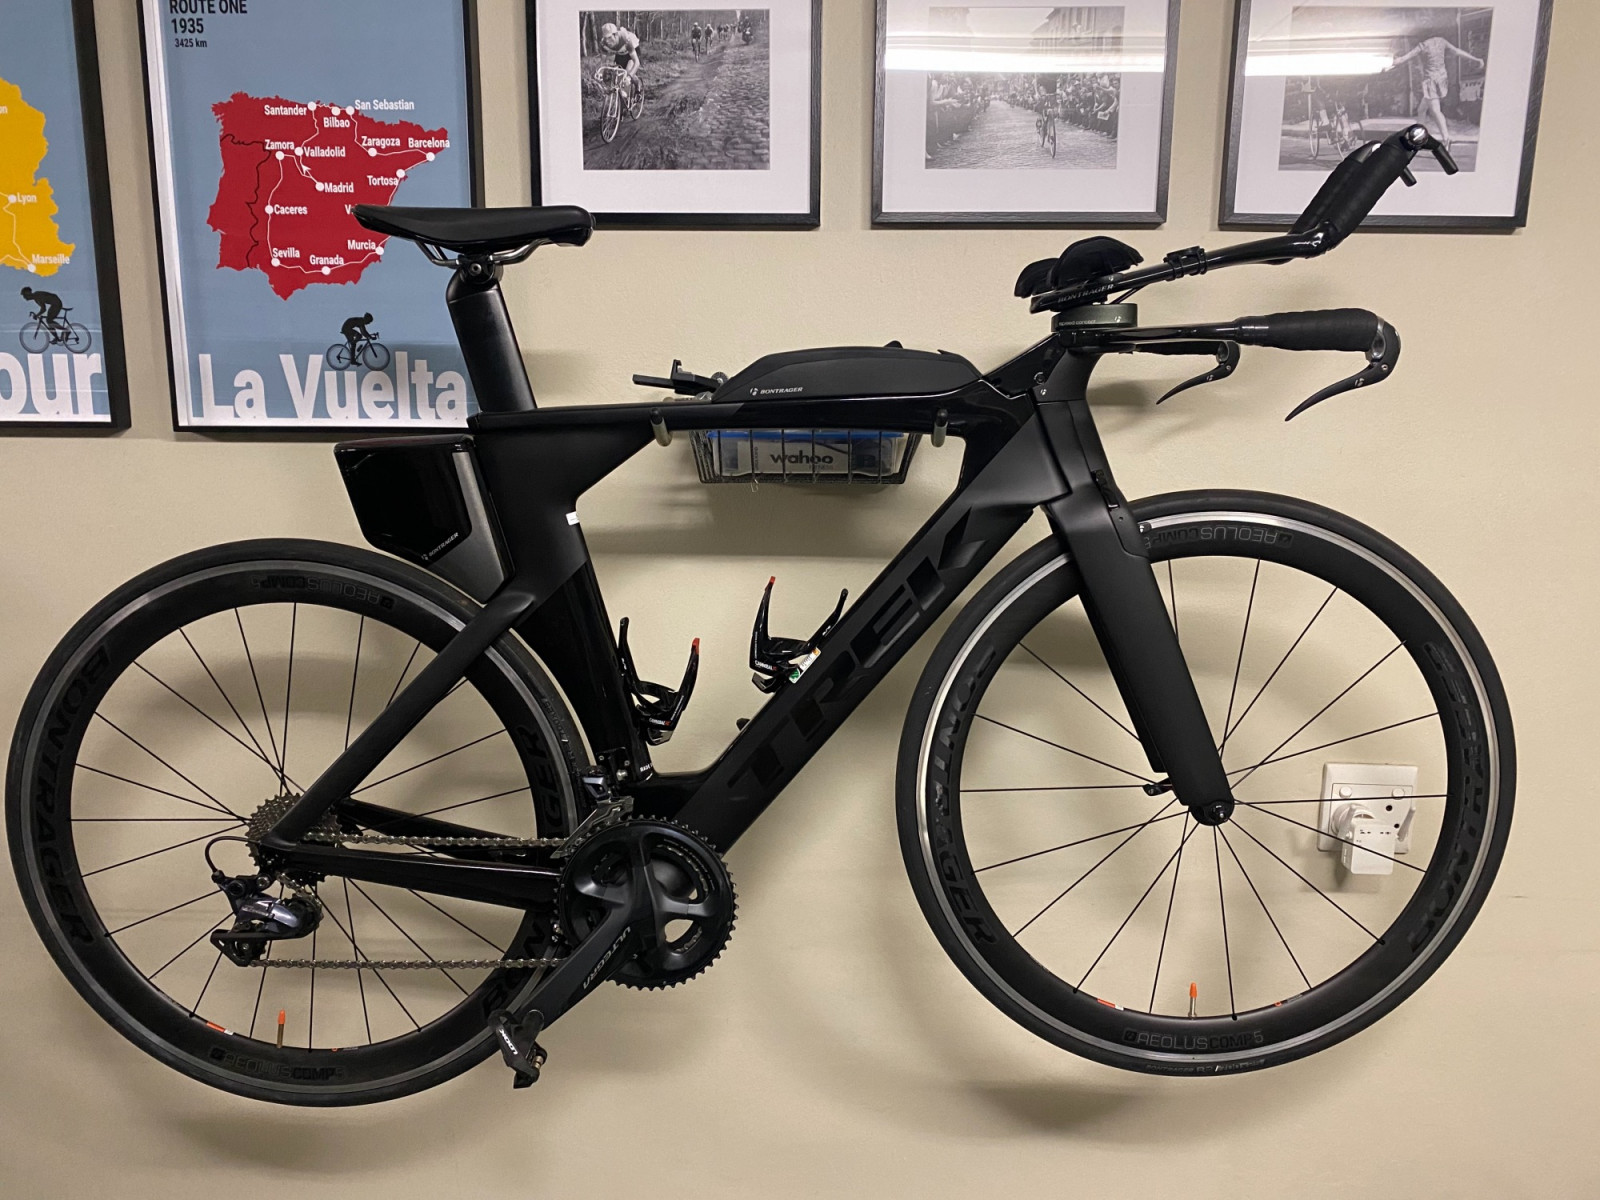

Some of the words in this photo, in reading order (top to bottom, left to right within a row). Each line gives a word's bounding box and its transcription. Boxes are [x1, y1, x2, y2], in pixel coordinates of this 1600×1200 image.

[170, 0, 215, 14] ROUTE
[219, 0, 247, 14] ONE
[171, 18, 204, 34] 1935
[175, 38, 193, 48] 3425
[195, 38, 207, 48] km
[264, 105, 307, 116] Santander
[355, 100, 370, 110] San
[373, 100, 414, 110] Sebastian
[323, 117, 350, 128] Bilbao
[265, 140, 295, 151] Zamora
[361, 136, 400, 149] Zaragoza
[408, 137, 450, 148] Barcelona
[304, 147, 346, 157] Valladolid
[367, 175, 398, 186] Tortosa
[324, 182, 354, 193] Madrid
[17, 193, 37, 204] Lyon
[273, 204, 308, 215] Caceres
[347, 240, 376, 250] Murcia
[272, 247, 300, 258] Sevilla
[32, 254, 70, 264] Marseille
[309, 254, 344, 265] Granada
[199, 353, 268, 418] La
[279, 351, 467, 419] Vuelta
[760, 387, 803, 395] BONTRAGER
[769, 450, 834, 464] wahoo
[428, 532, 459, 557] BONTRAGER
[726, 506, 987, 790] TREK
[37, 644, 110, 942] BONTRAGER
[583, 926, 632, 990] ULTEGRA
[499, 1027, 519, 1055] LOOK
